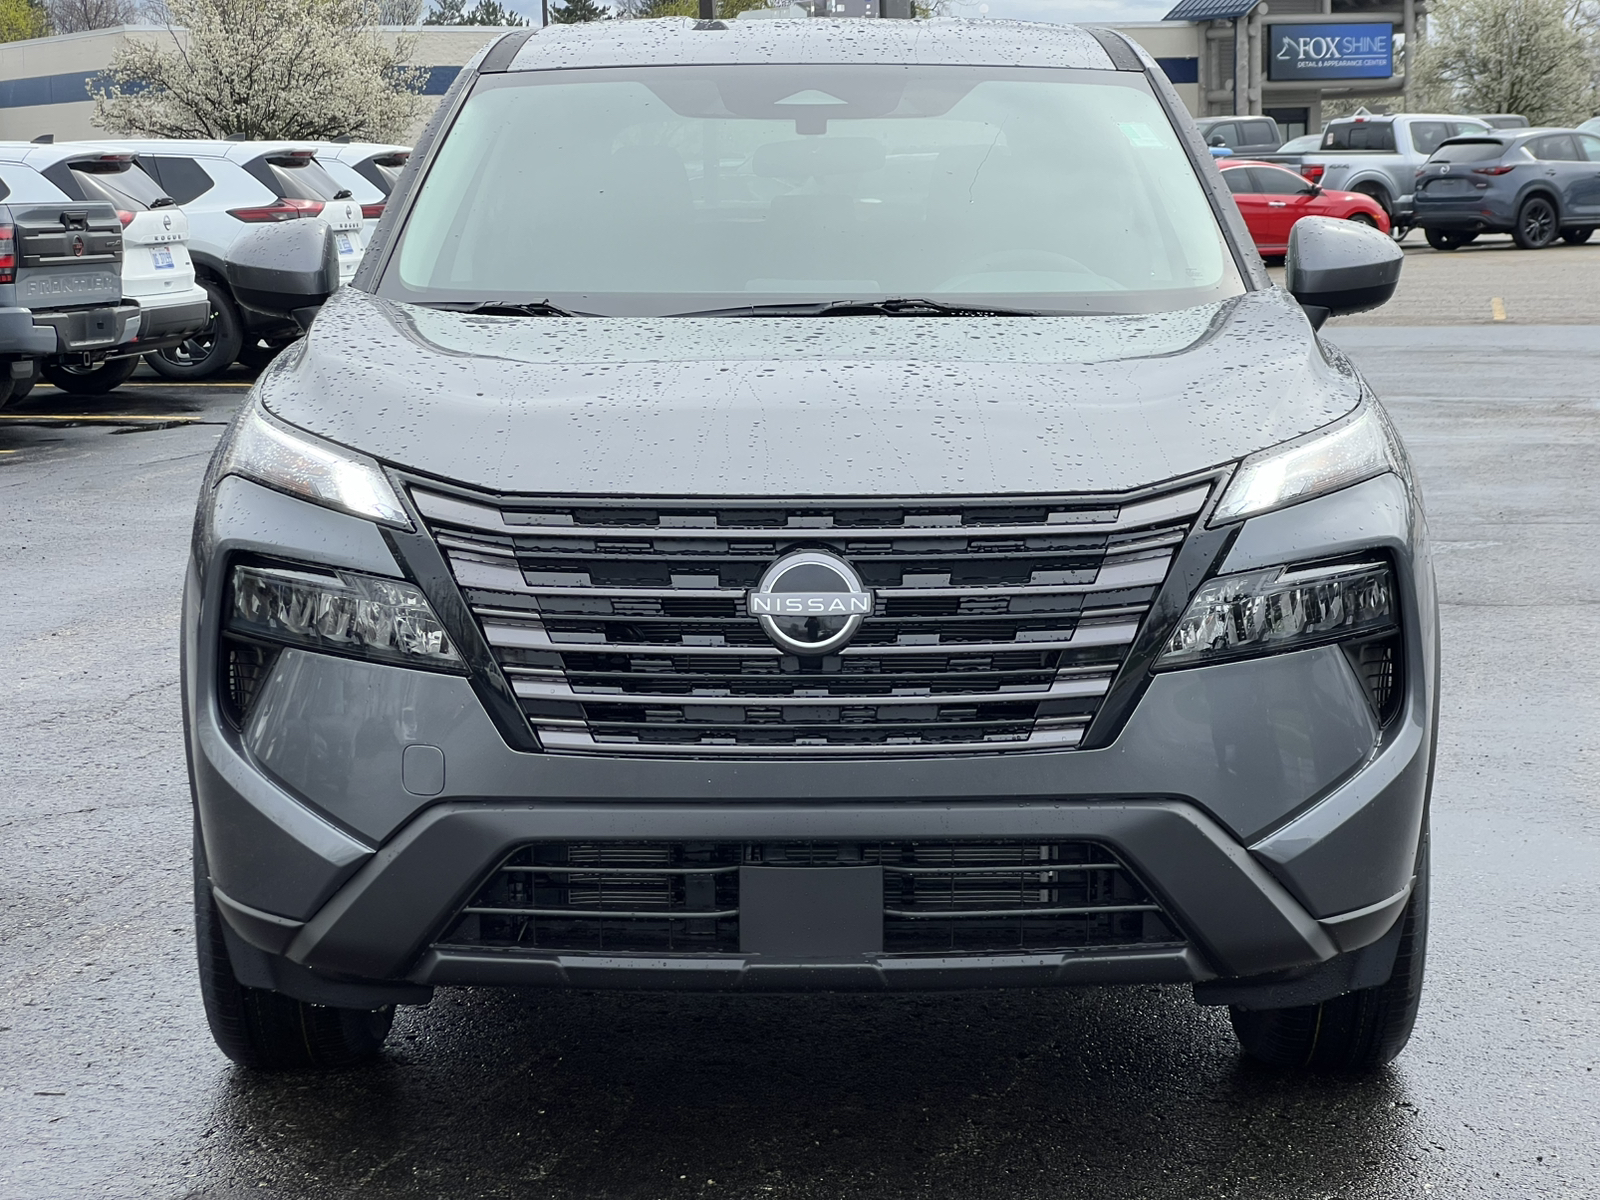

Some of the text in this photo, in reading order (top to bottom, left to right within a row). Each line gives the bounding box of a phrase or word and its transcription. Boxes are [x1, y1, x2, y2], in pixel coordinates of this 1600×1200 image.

[1298, 36, 1387, 59] FOX SHINE
[27, 276, 113, 295] FRONTIER
[754, 597, 868, 612] NISSAN
